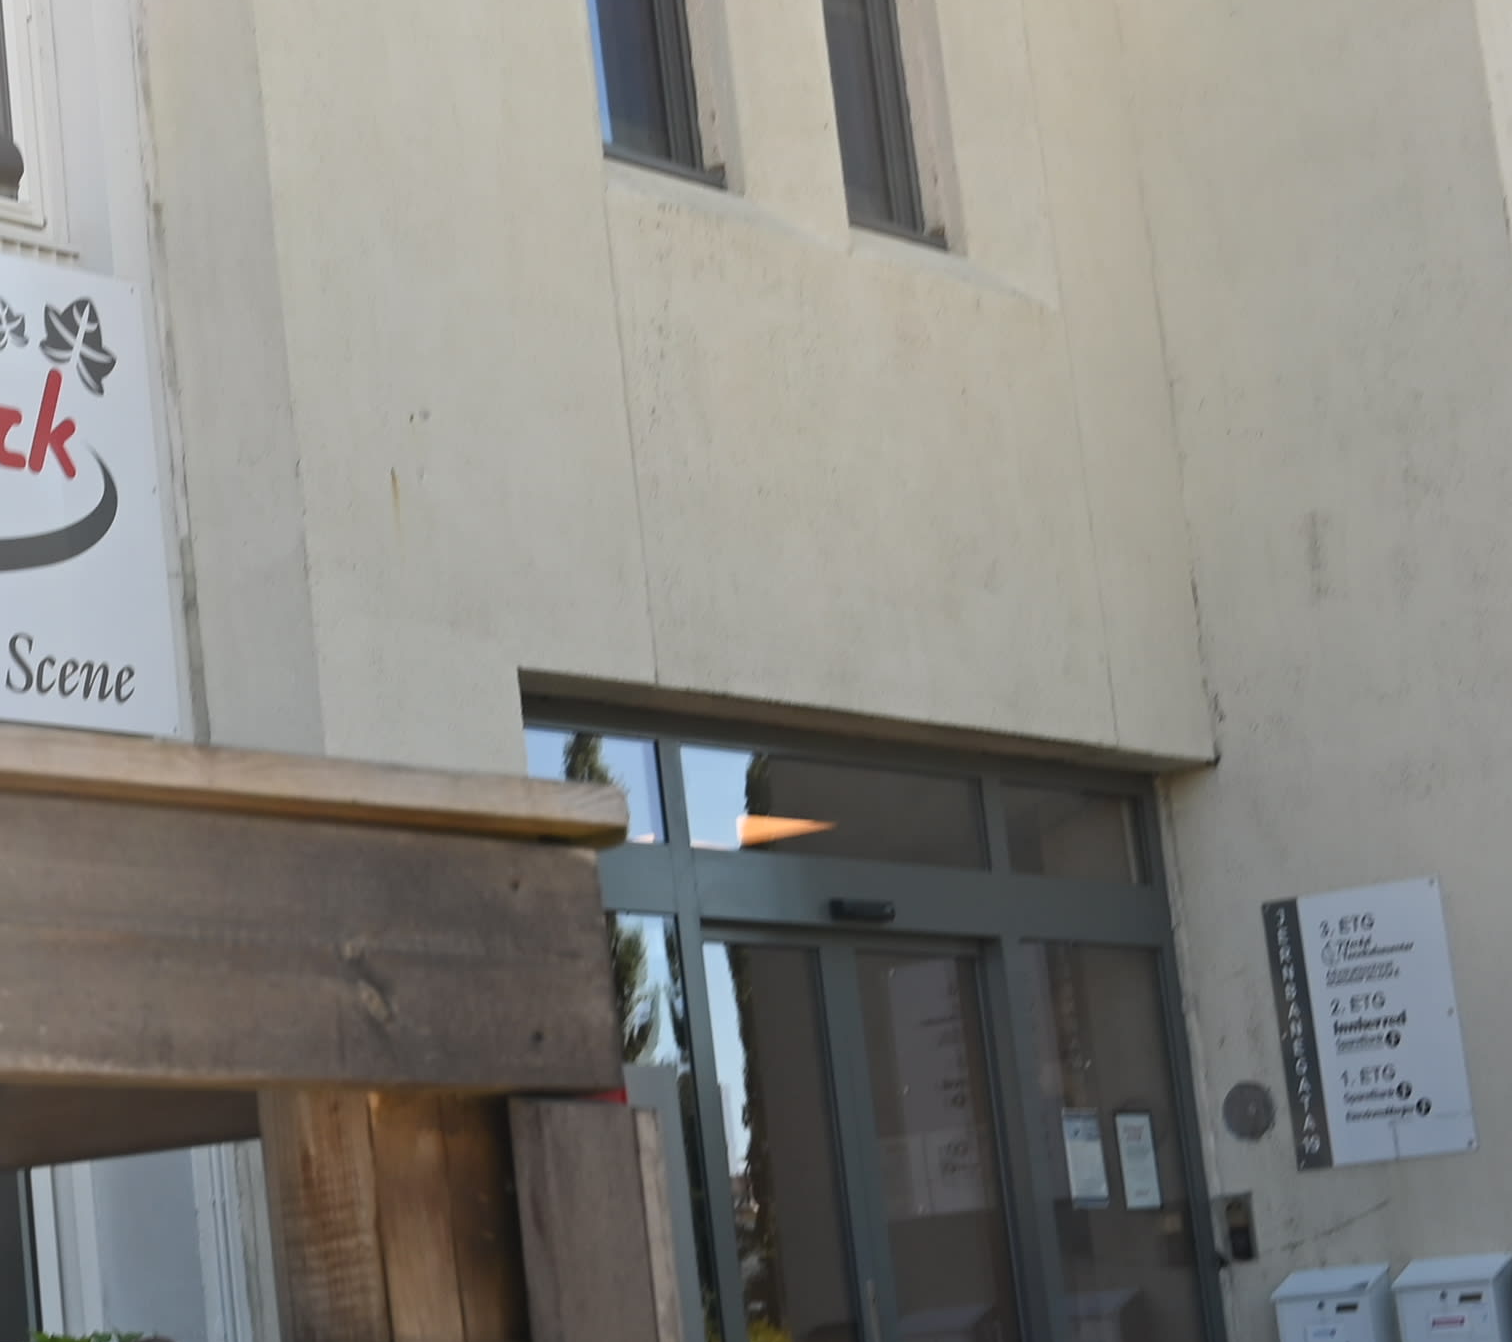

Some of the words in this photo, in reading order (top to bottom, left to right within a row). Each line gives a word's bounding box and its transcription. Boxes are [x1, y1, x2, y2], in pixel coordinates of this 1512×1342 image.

[4, 631, 137, 706] Scene
[1338, 911, 1375, 935] ETG
[1349, 990, 1386, 1014] ETG
[1359, 1063, 1396, 1086] ETG
